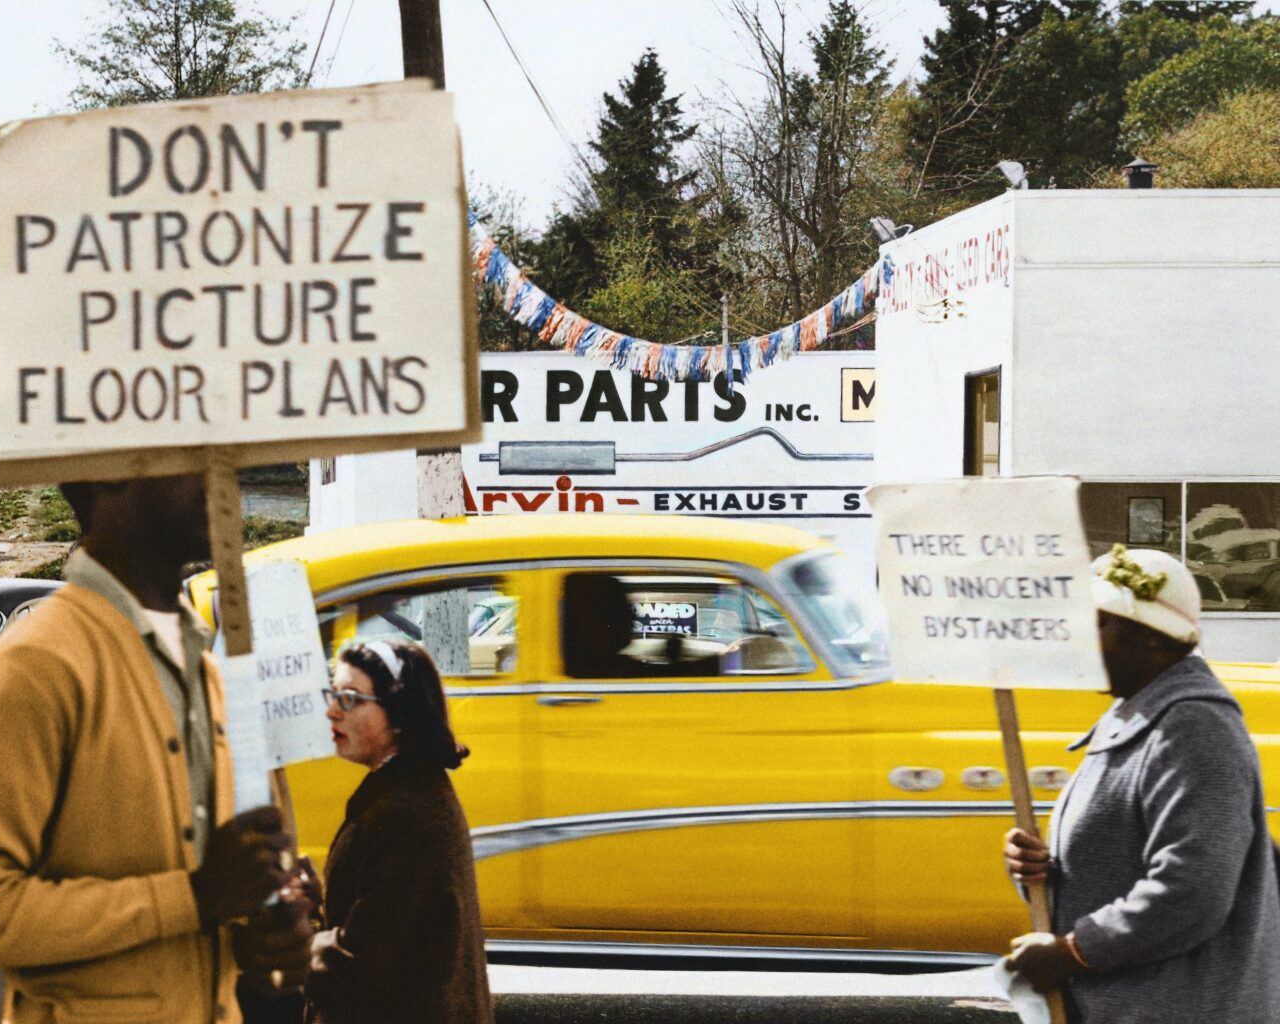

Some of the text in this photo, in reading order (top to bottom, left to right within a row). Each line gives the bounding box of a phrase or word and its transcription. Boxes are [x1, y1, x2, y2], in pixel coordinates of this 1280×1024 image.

[108, 119, 343, 197] DON'T
[15, 202, 425, 274] PATRONIZE
[80, 278, 377, 352] PICTURE
[20, 356, 429, 424] FLOOR PLANS
[483, 370, 519, 422] R
[546, 369, 747, 422] PARTS
[765, 403, 819, 422] INC.
[654, 493, 808, 511] EXHAUST
[844, 493, 861, 511] S
[888, 534, 1065, 557] THERE CAN BE
[901, 574, 1074, 599] NO INNOCENT
[923, 616, 1071, 641] BYSTANDERS
